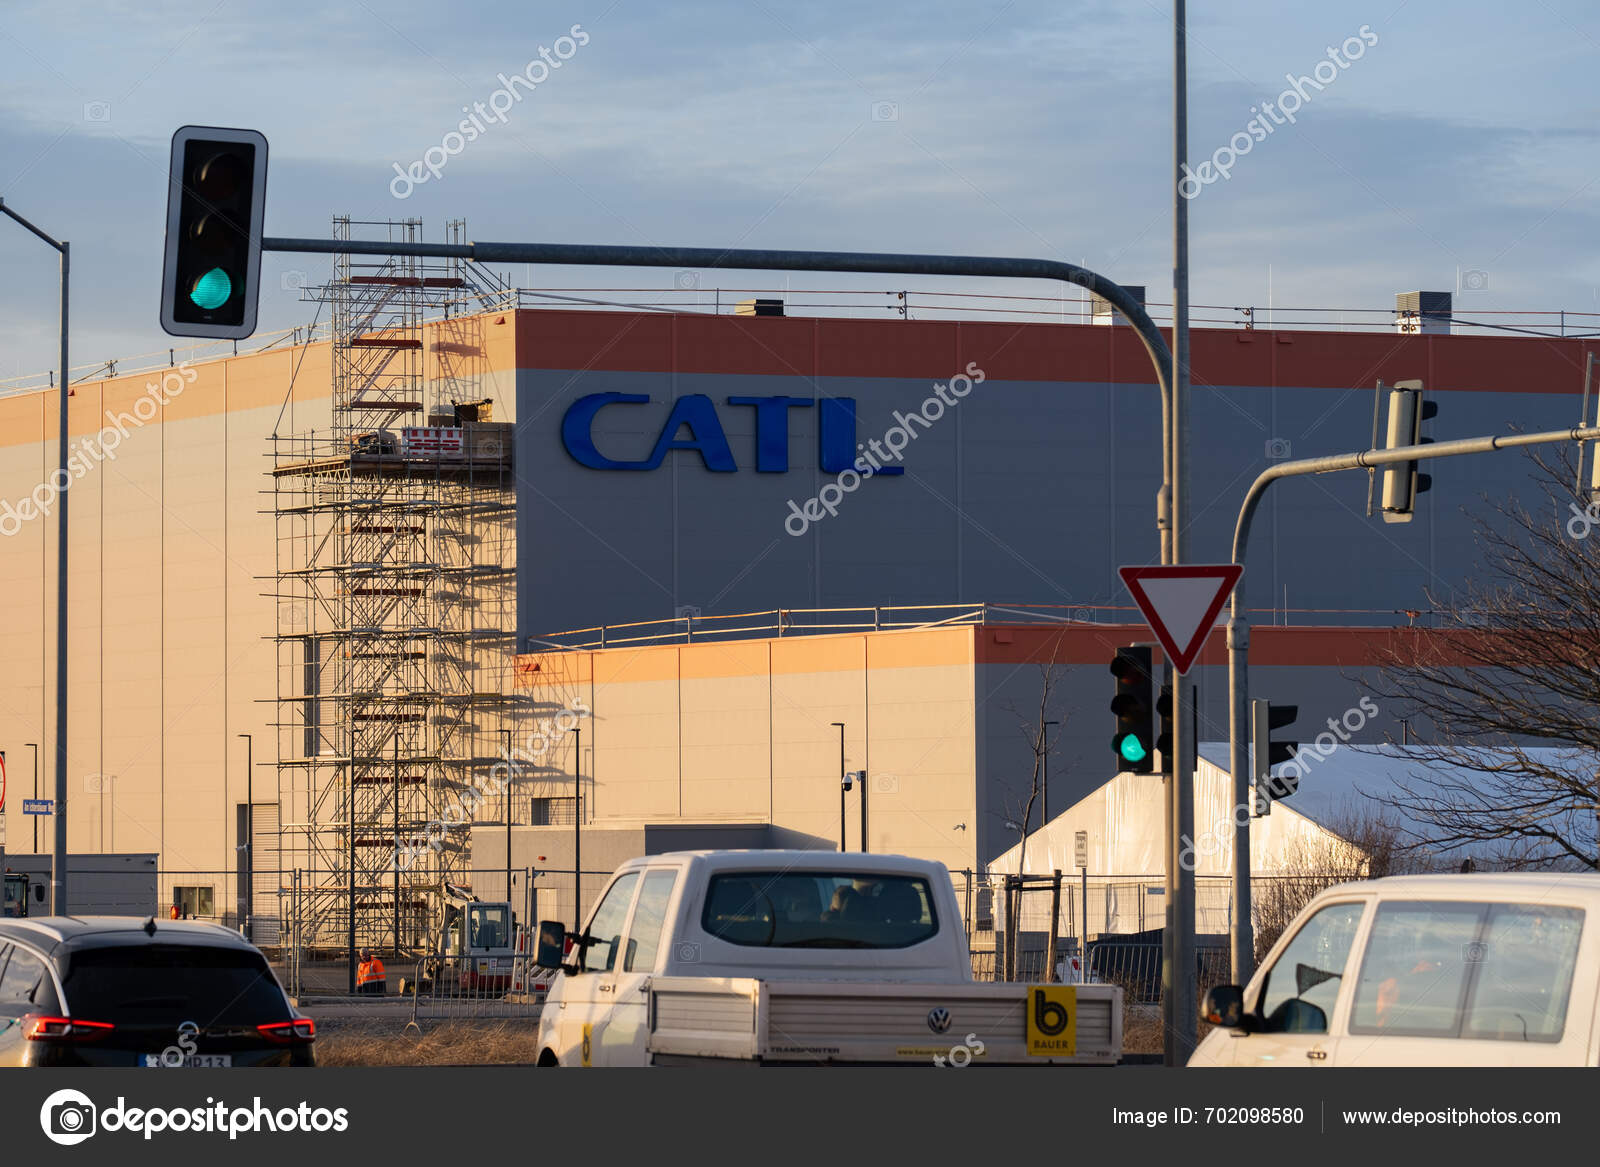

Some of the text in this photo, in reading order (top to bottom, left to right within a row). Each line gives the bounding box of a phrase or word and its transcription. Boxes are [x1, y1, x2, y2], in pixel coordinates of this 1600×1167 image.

[561, 392, 904, 475] CATL
[1033, 1040, 1068, 1049] BAUER
[770, 1047, 840, 1055] TRANSPORTER
